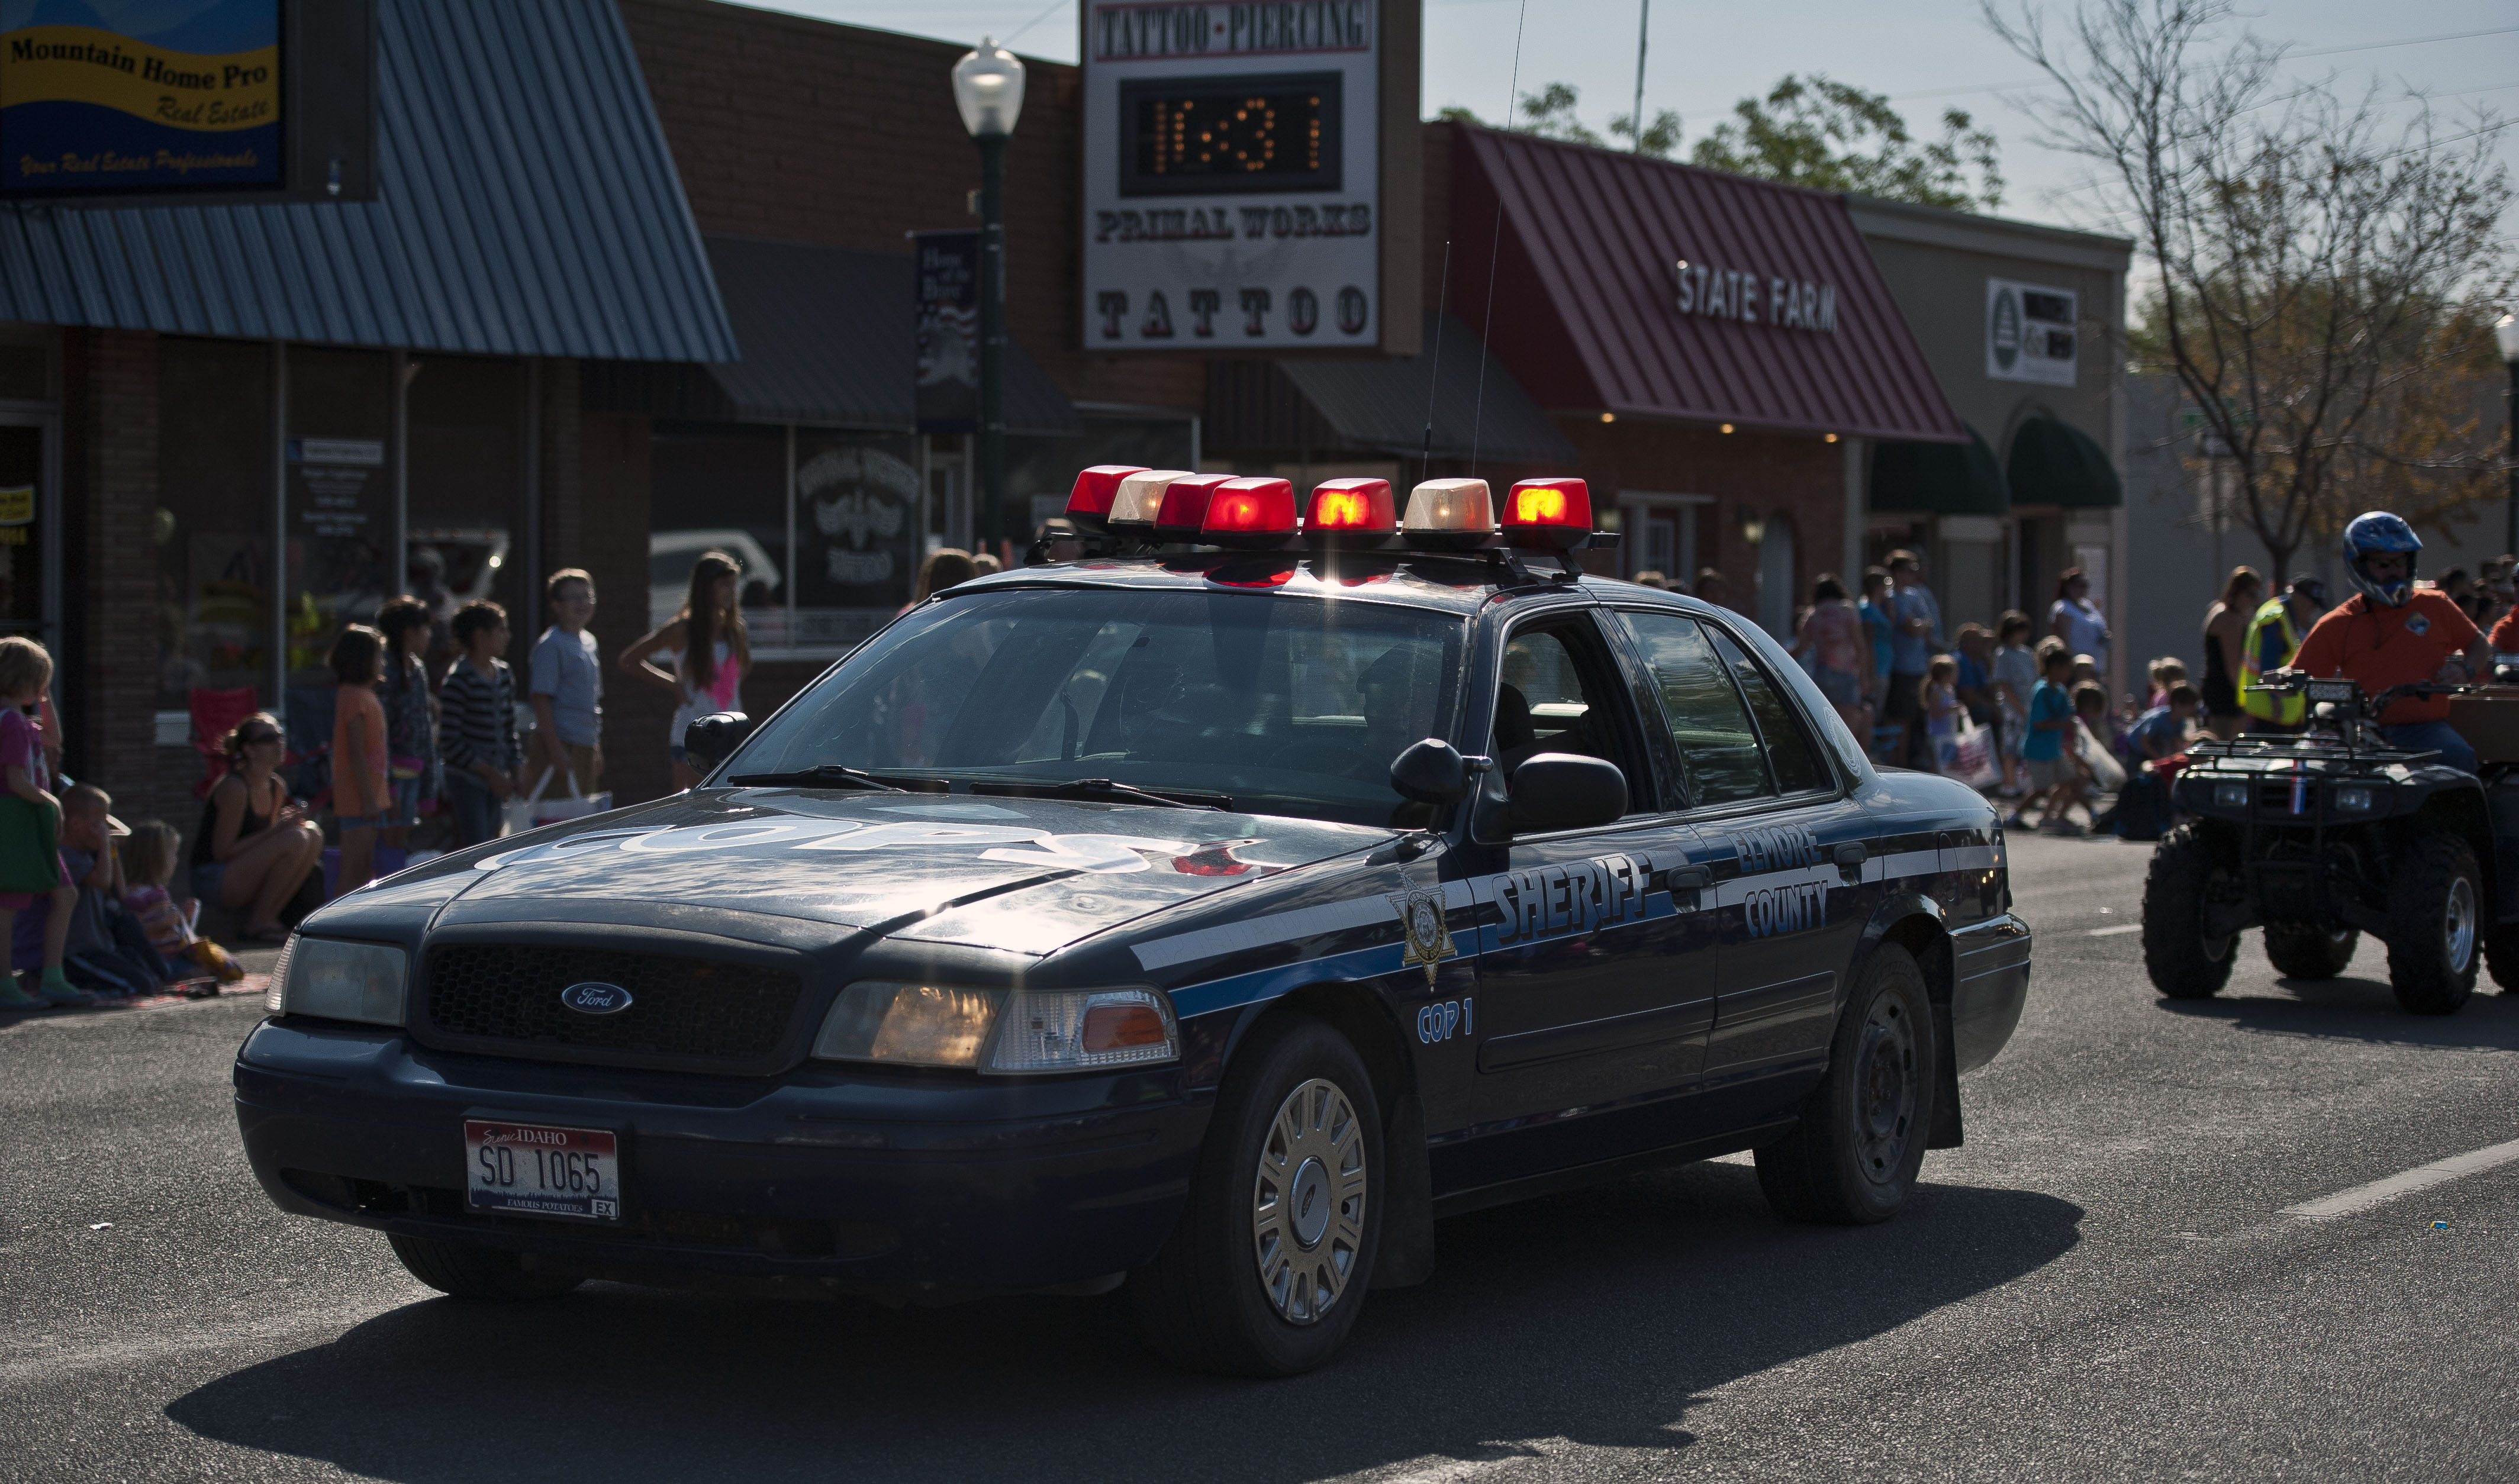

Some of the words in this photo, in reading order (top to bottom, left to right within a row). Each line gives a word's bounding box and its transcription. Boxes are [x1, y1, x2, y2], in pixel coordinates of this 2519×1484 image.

[1096, 7, 1209, 55] TATTOO
[1231, 2, 1365, 51] PIERCING
[11, 39, 136, 73] Mountain
[142, 56, 215, 90] Home
[223, 64, 268, 89] Pro
[156, 96, 205, 125] Real
[207, 99, 269, 125] Estate
[61, 151, 101, 173] Real
[1096, 206, 1233, 242] PRIMAL
[1239, 202, 1371, 239] WORKS
[1096, 285, 1367, 338] TATTOO
[1676, 264, 1758, 324] STATE
[1769, 275, 1838, 334] FARM
[1726, 823, 1822, 873] ELMORE
[1492, 852, 1654, 943] SHERIFF
[1745, 880, 1829, 938] COUNTY
[577, 988, 614, 1006] Ford
[1418, 1001, 1460, 1044] COP
[1463, 998, 1472, 1035] 1
[482, 1129, 518, 1146] Scenic
[516, 1128, 567, 1146] IDAHO
[479, 1145, 515, 1186] SD
[534, 1148, 601, 1194] 1065
[507, 1199, 540, 1209] FAMOUS
[541, 1201, 583, 1213] POTATOES
[595, 1201, 613, 1215] EX
